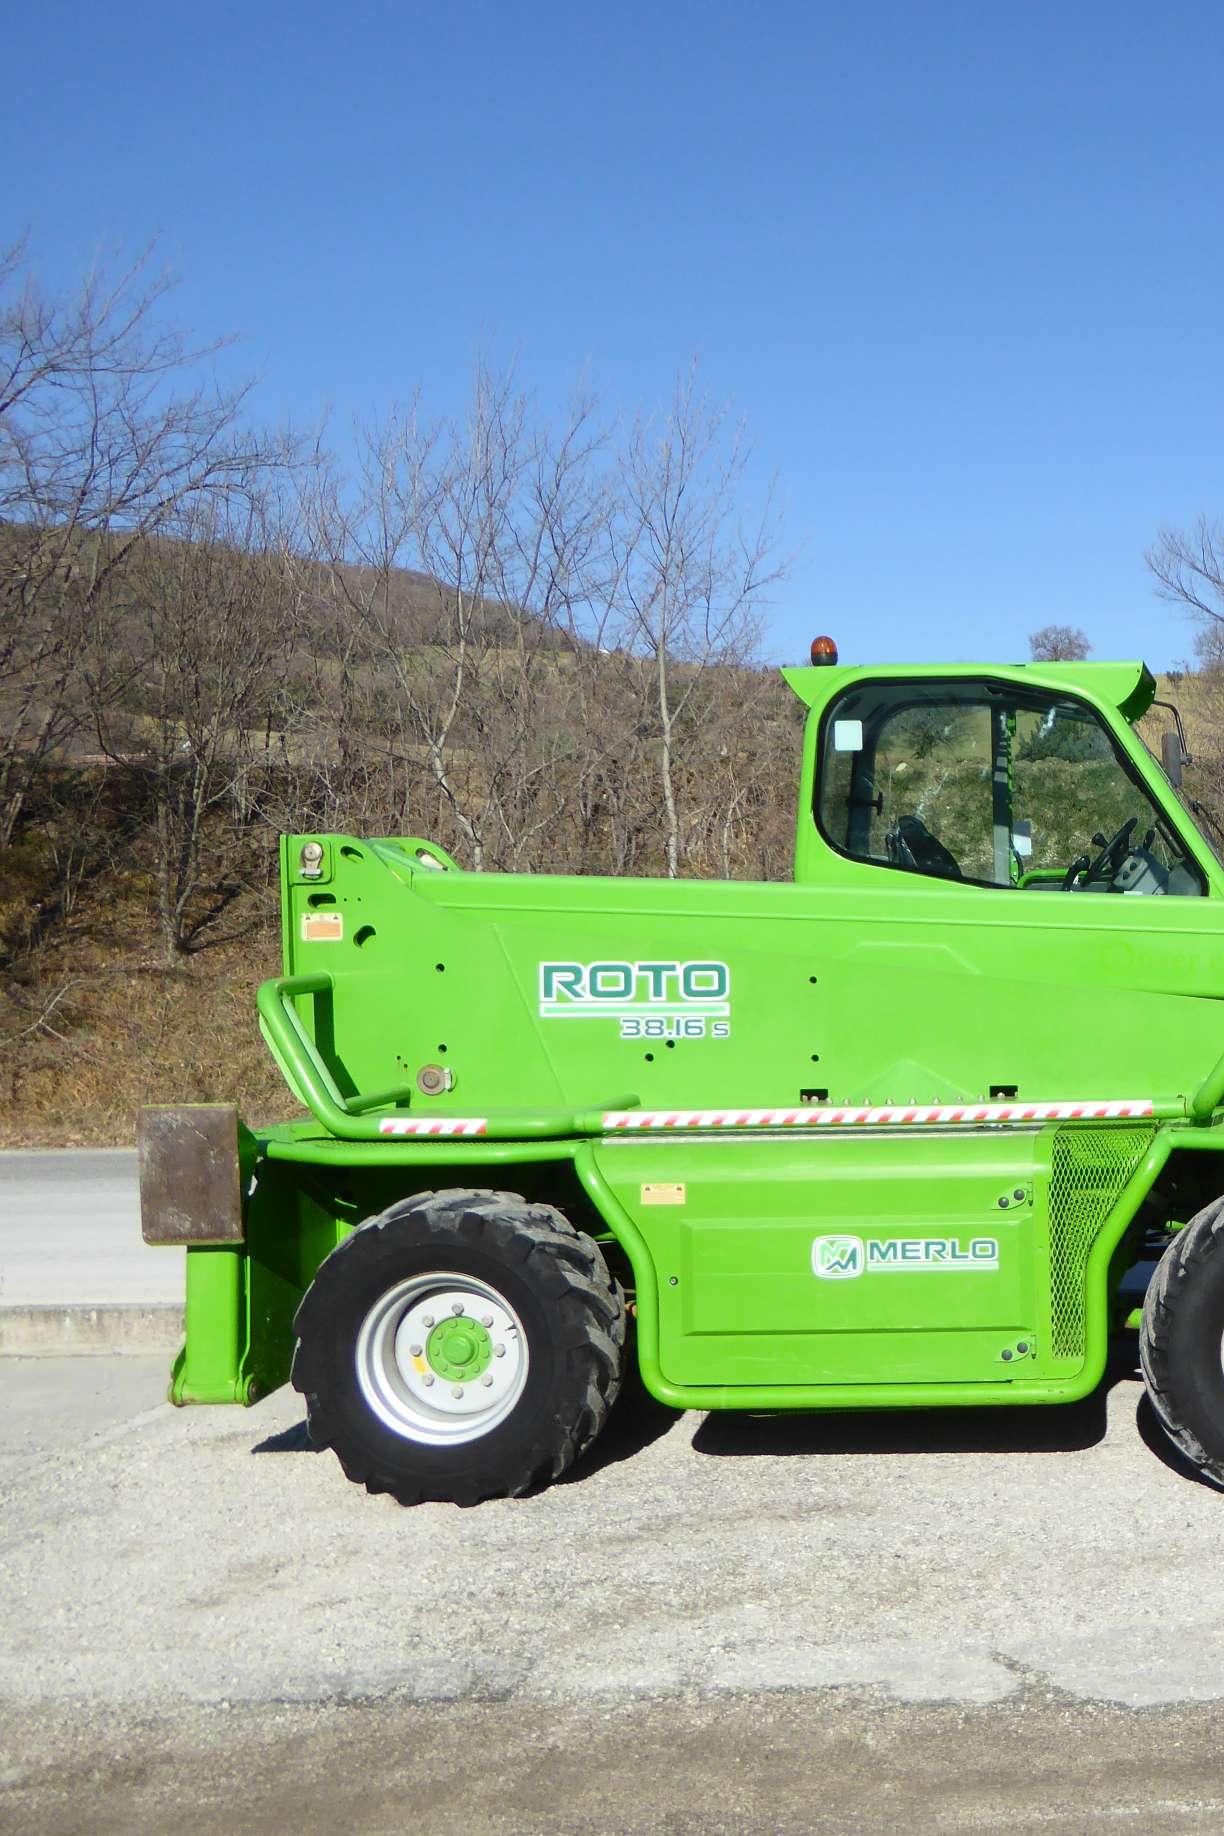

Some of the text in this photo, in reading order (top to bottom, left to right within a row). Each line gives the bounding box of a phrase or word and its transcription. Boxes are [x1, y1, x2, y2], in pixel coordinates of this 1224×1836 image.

[542, 963, 728, 999] ROTO
[621, 1018, 704, 1037] 38.16
[869, 1240, 997, 1260] MERLO
